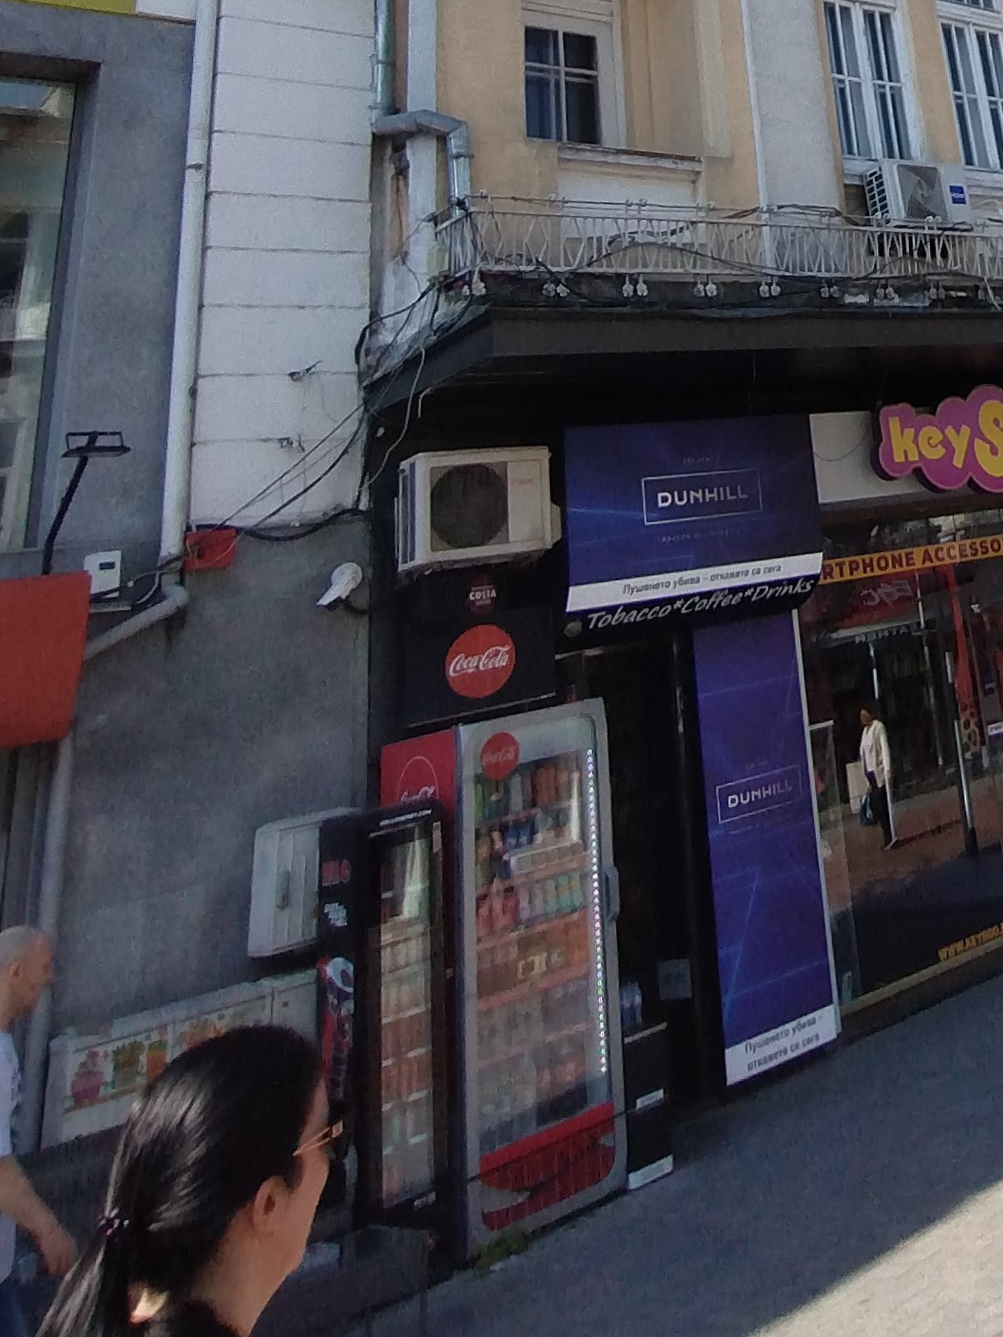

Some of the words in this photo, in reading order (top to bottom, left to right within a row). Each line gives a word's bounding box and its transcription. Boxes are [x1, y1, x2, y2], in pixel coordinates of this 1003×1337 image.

[657, 484, 748, 508] DUNHILL
[469, 589, 497, 601] COSTA
[449, 644, 512, 677] Coca-Cola
[727, 780, 794, 808] DUNHILL
